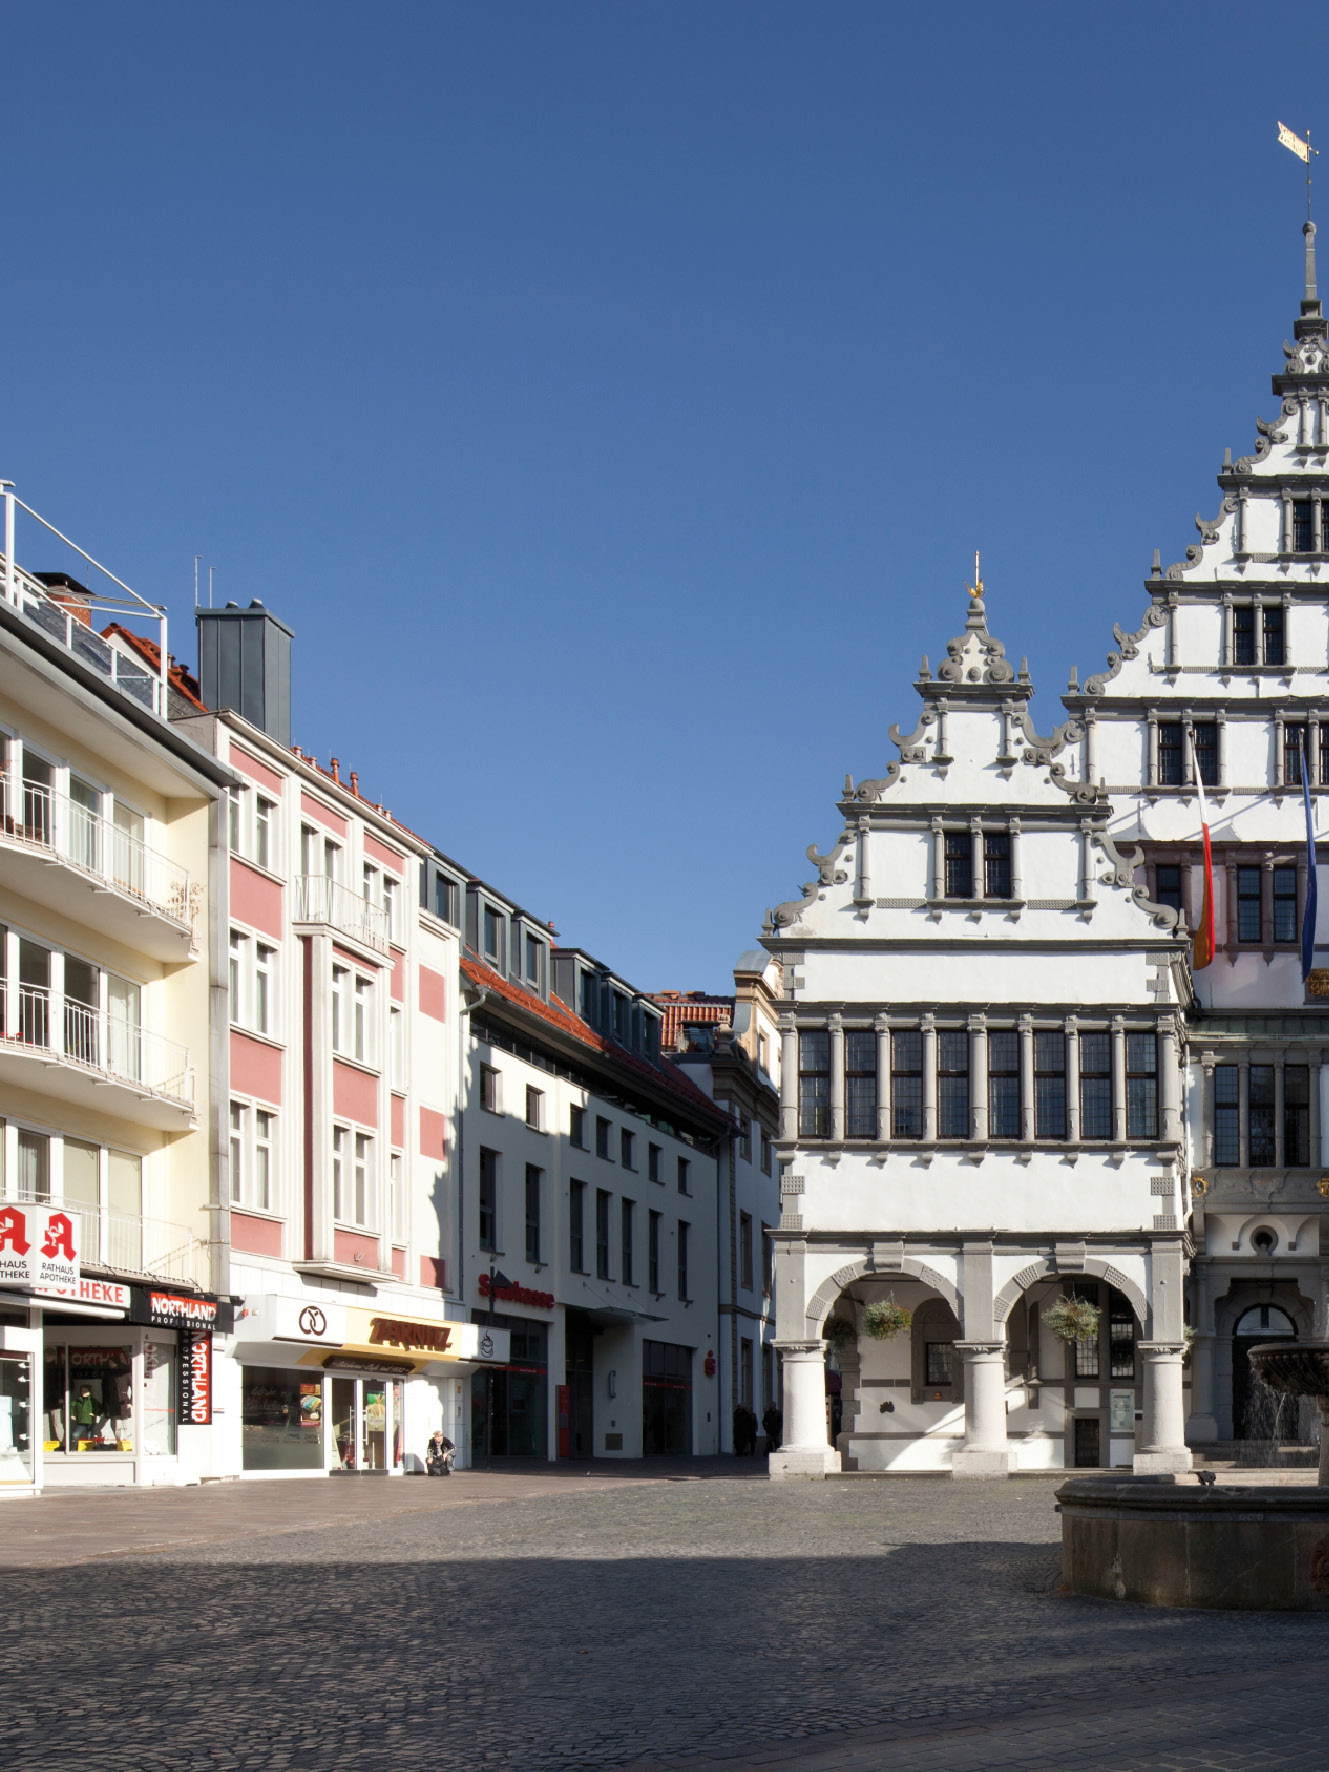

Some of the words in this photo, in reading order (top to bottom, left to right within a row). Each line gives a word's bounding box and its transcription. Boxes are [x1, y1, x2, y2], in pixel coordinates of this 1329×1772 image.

[42, 1262, 73, 1276] RATHAUS
[40, 1272, 76, 1285] APOTHEKE
[151, 1297, 216, 1322] NORTHLAND
[151, 1315, 216, 1331] PROFESSIONAL
[190, 1330, 208, 1423] NORTHLAND
